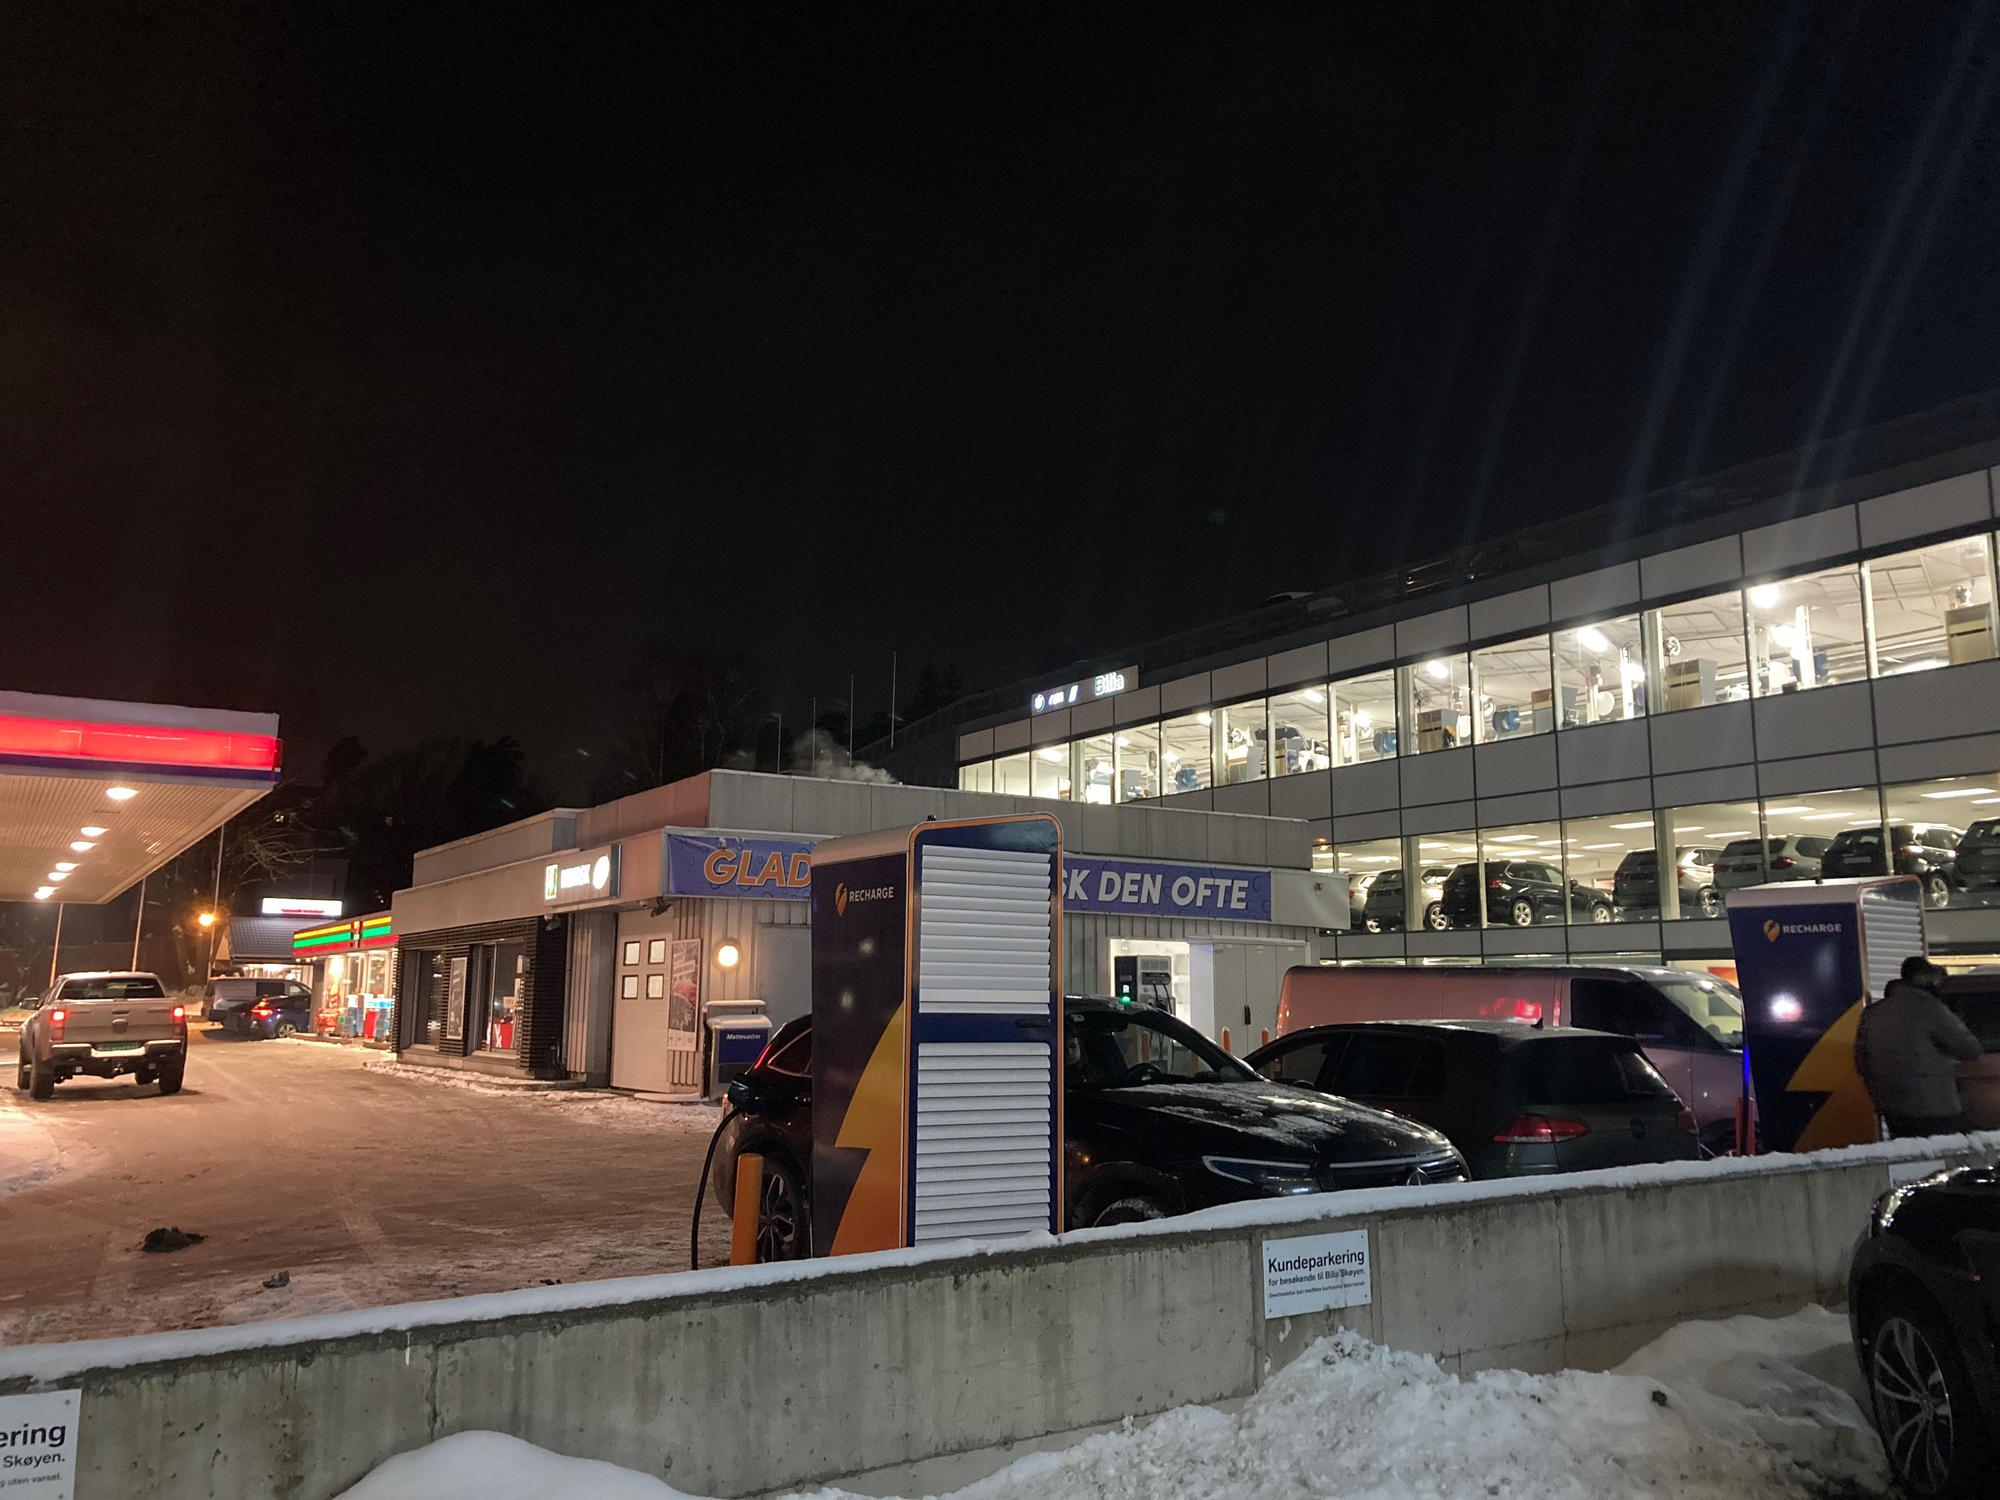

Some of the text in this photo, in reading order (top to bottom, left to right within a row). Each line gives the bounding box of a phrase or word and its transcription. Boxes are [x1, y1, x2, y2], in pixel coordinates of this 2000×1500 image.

[1095, 672, 1125, 696] Bilia
[704, 848, 811, 888] GLAD
[849, 886, 894, 902] RECHARGE
[1098, 871, 1163, 904] DEN
[1171, 876, 1249, 909] OFTE
[1783, 923, 1842, 934] RECHARGE
[1268, 1249, 1365, 1273] Kundeparkering
[1269, 1278, 1278, 1287] for
[1279, 1273, 1316, 1285] besøkende
[3, 1453, 65, 1468] Skøyen.
